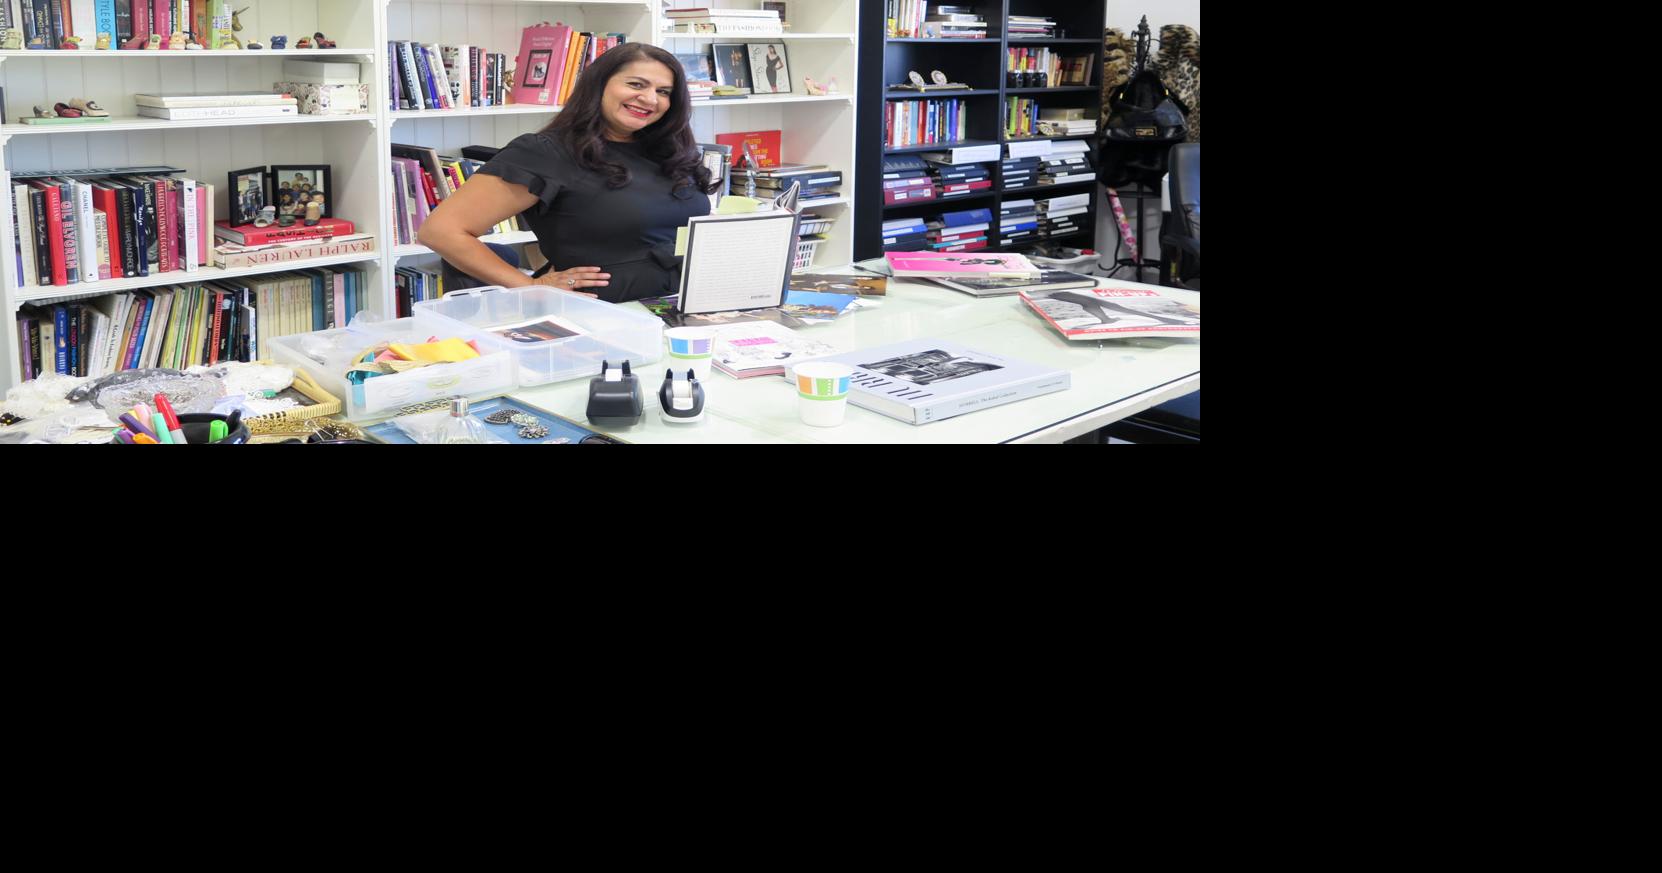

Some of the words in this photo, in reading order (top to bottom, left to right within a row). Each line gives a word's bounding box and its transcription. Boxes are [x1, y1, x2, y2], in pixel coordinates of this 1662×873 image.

[100, 0, 110, 16] TYLE
[60, 200, 72, 220] GIL
[62, 221, 78, 269] ELVGREN
[319, 242, 370, 256] RALPH
[246, 248, 312, 264] LAUREN
